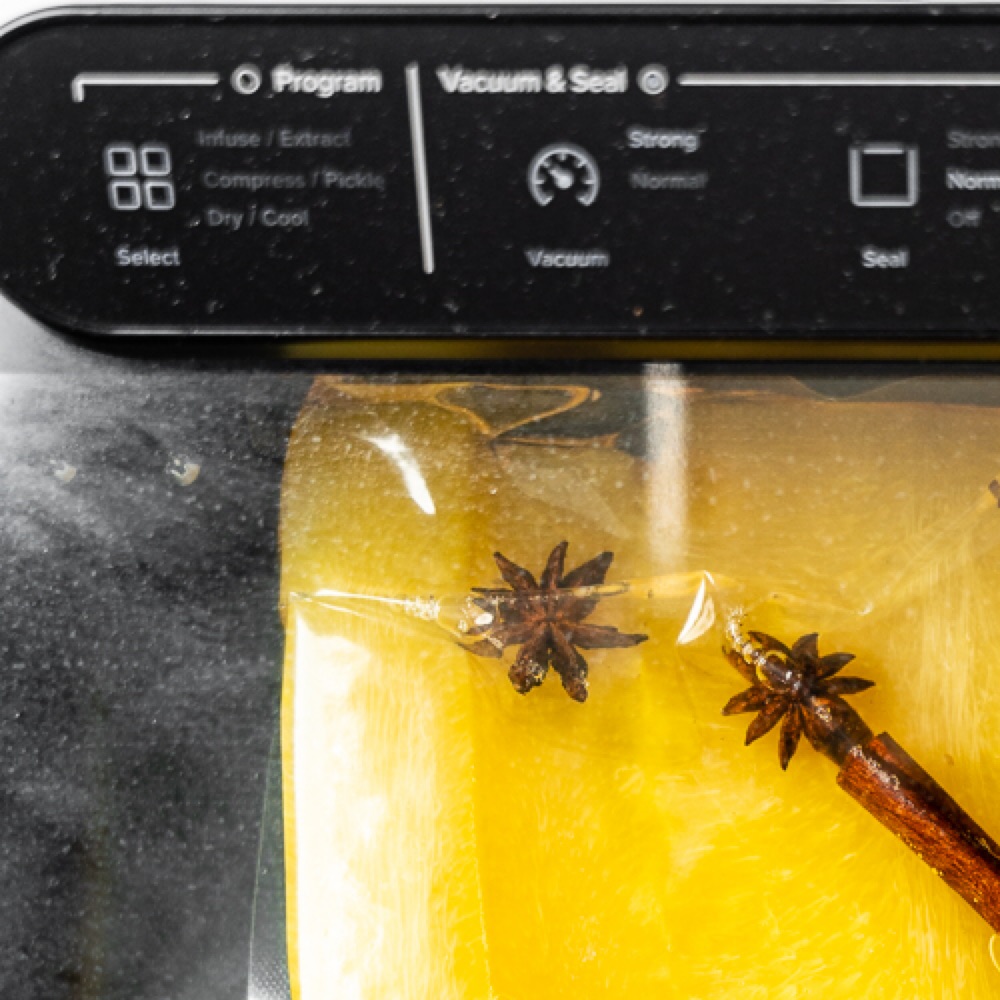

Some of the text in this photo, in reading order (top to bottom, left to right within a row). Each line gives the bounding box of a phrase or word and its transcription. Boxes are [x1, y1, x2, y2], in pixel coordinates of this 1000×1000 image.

[272, 63, 382, 98] Program
[437, 64, 628, 93] Vacuum & Seal
[198, 129, 260, 147] Infuse
[280, 129, 351, 147] Extract
[627, 126, 699, 152] Strong
[203, 171, 305, 190] Compress
[629, 169, 708, 190] Normal
[204, 208, 244, 230] Dry
[261, 207, 309, 227] Cool
[116, 246, 181, 267] Select
[525, 249, 610, 268] Vacuum
[861, 247, 909, 268] Seal
